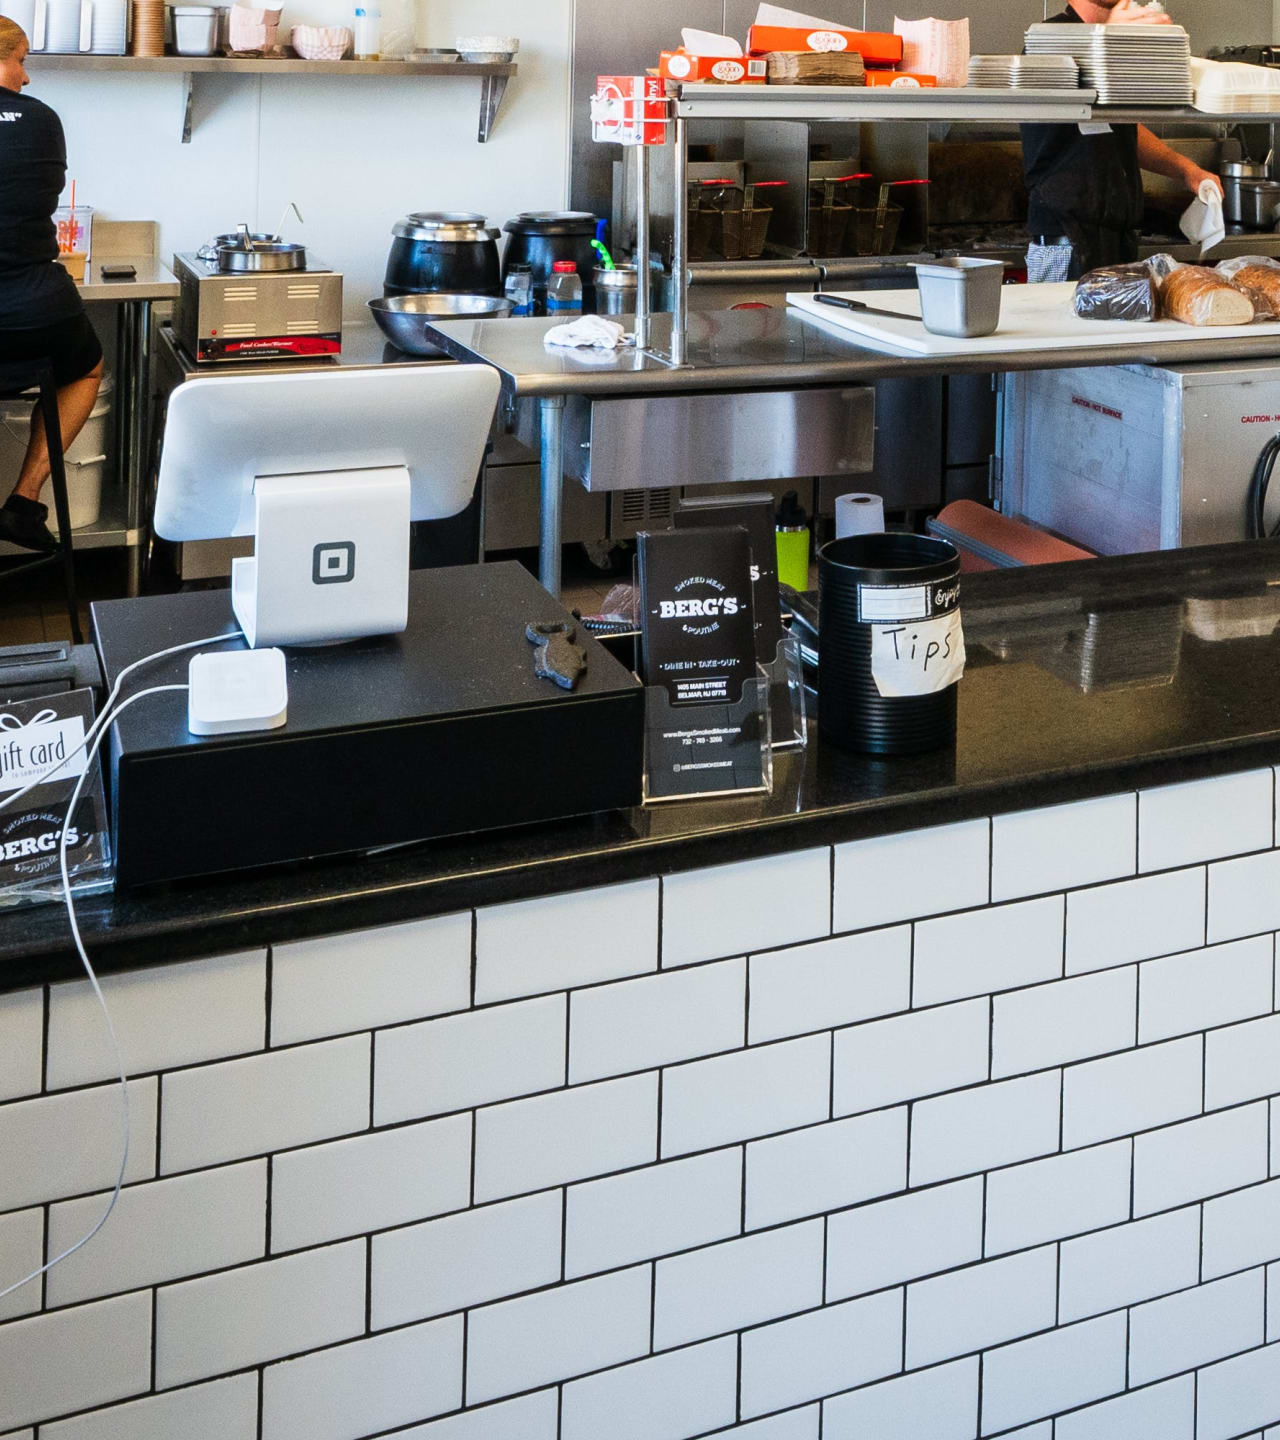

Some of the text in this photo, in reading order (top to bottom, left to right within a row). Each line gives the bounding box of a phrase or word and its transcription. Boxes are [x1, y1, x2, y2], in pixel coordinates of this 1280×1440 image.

[1241, 415, 1271, 424] CAUTION
[659, 597, 738, 618] BERG'S
[882, 627, 951, 671] Tips
[30, 731, 65, 766] card
